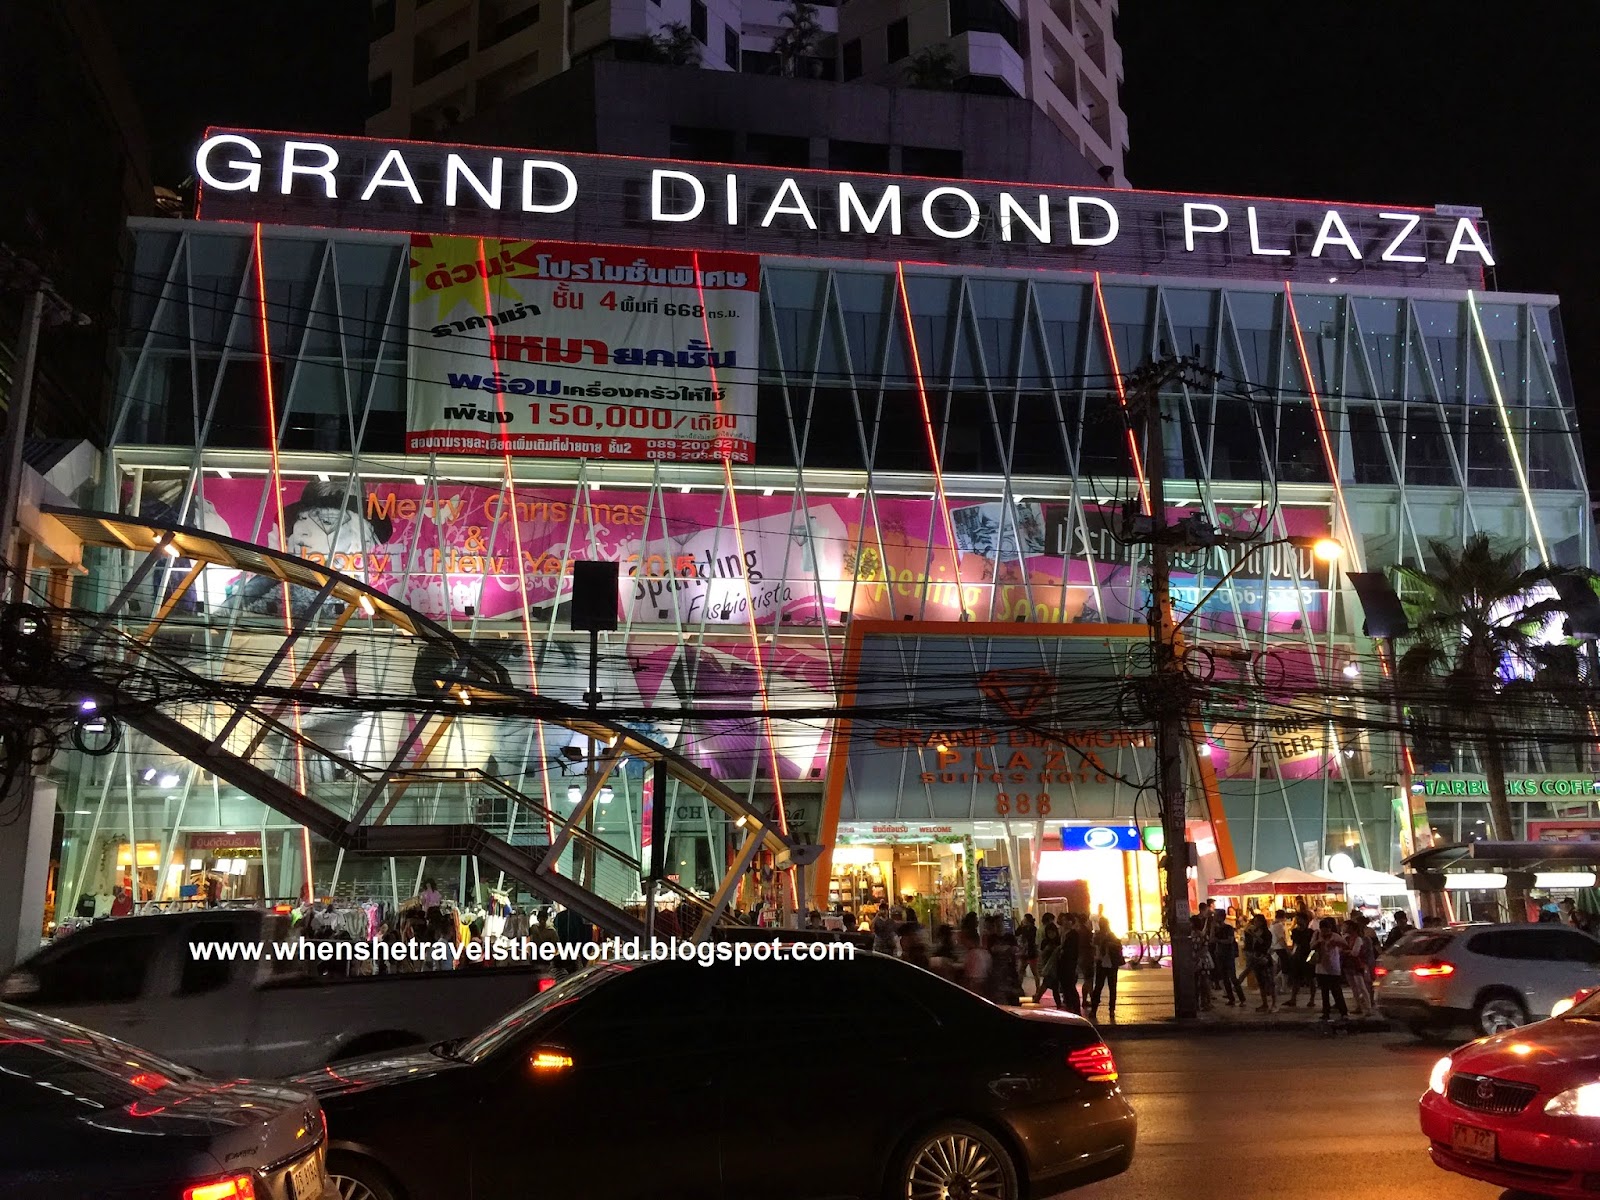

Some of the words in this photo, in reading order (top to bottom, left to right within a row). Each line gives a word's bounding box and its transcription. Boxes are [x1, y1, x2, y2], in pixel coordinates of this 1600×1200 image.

[197, 135, 577, 212] GRAND
[652, 170, 1118, 245] DIAMOND
[1184, 203, 1495, 265] PLAZA
[425, 250, 516, 291] ด่วน!
[536, 254, 748, 288] โปรโมชั่นพิเศษ
[553, 282, 584, 310] ชั้น
[600, 290, 617, 310] 4
[664, 303, 705, 318] 668
[367, 492, 464, 526] Mery
[465, 525, 486, 551] &
[432, 548, 504, 574] New
[627, 553, 697, 578] 205
[937, 750, 1105, 771] PLAZA
[996, 792, 1052, 815] 888
[1541, 779, 1600, 796] COFF
